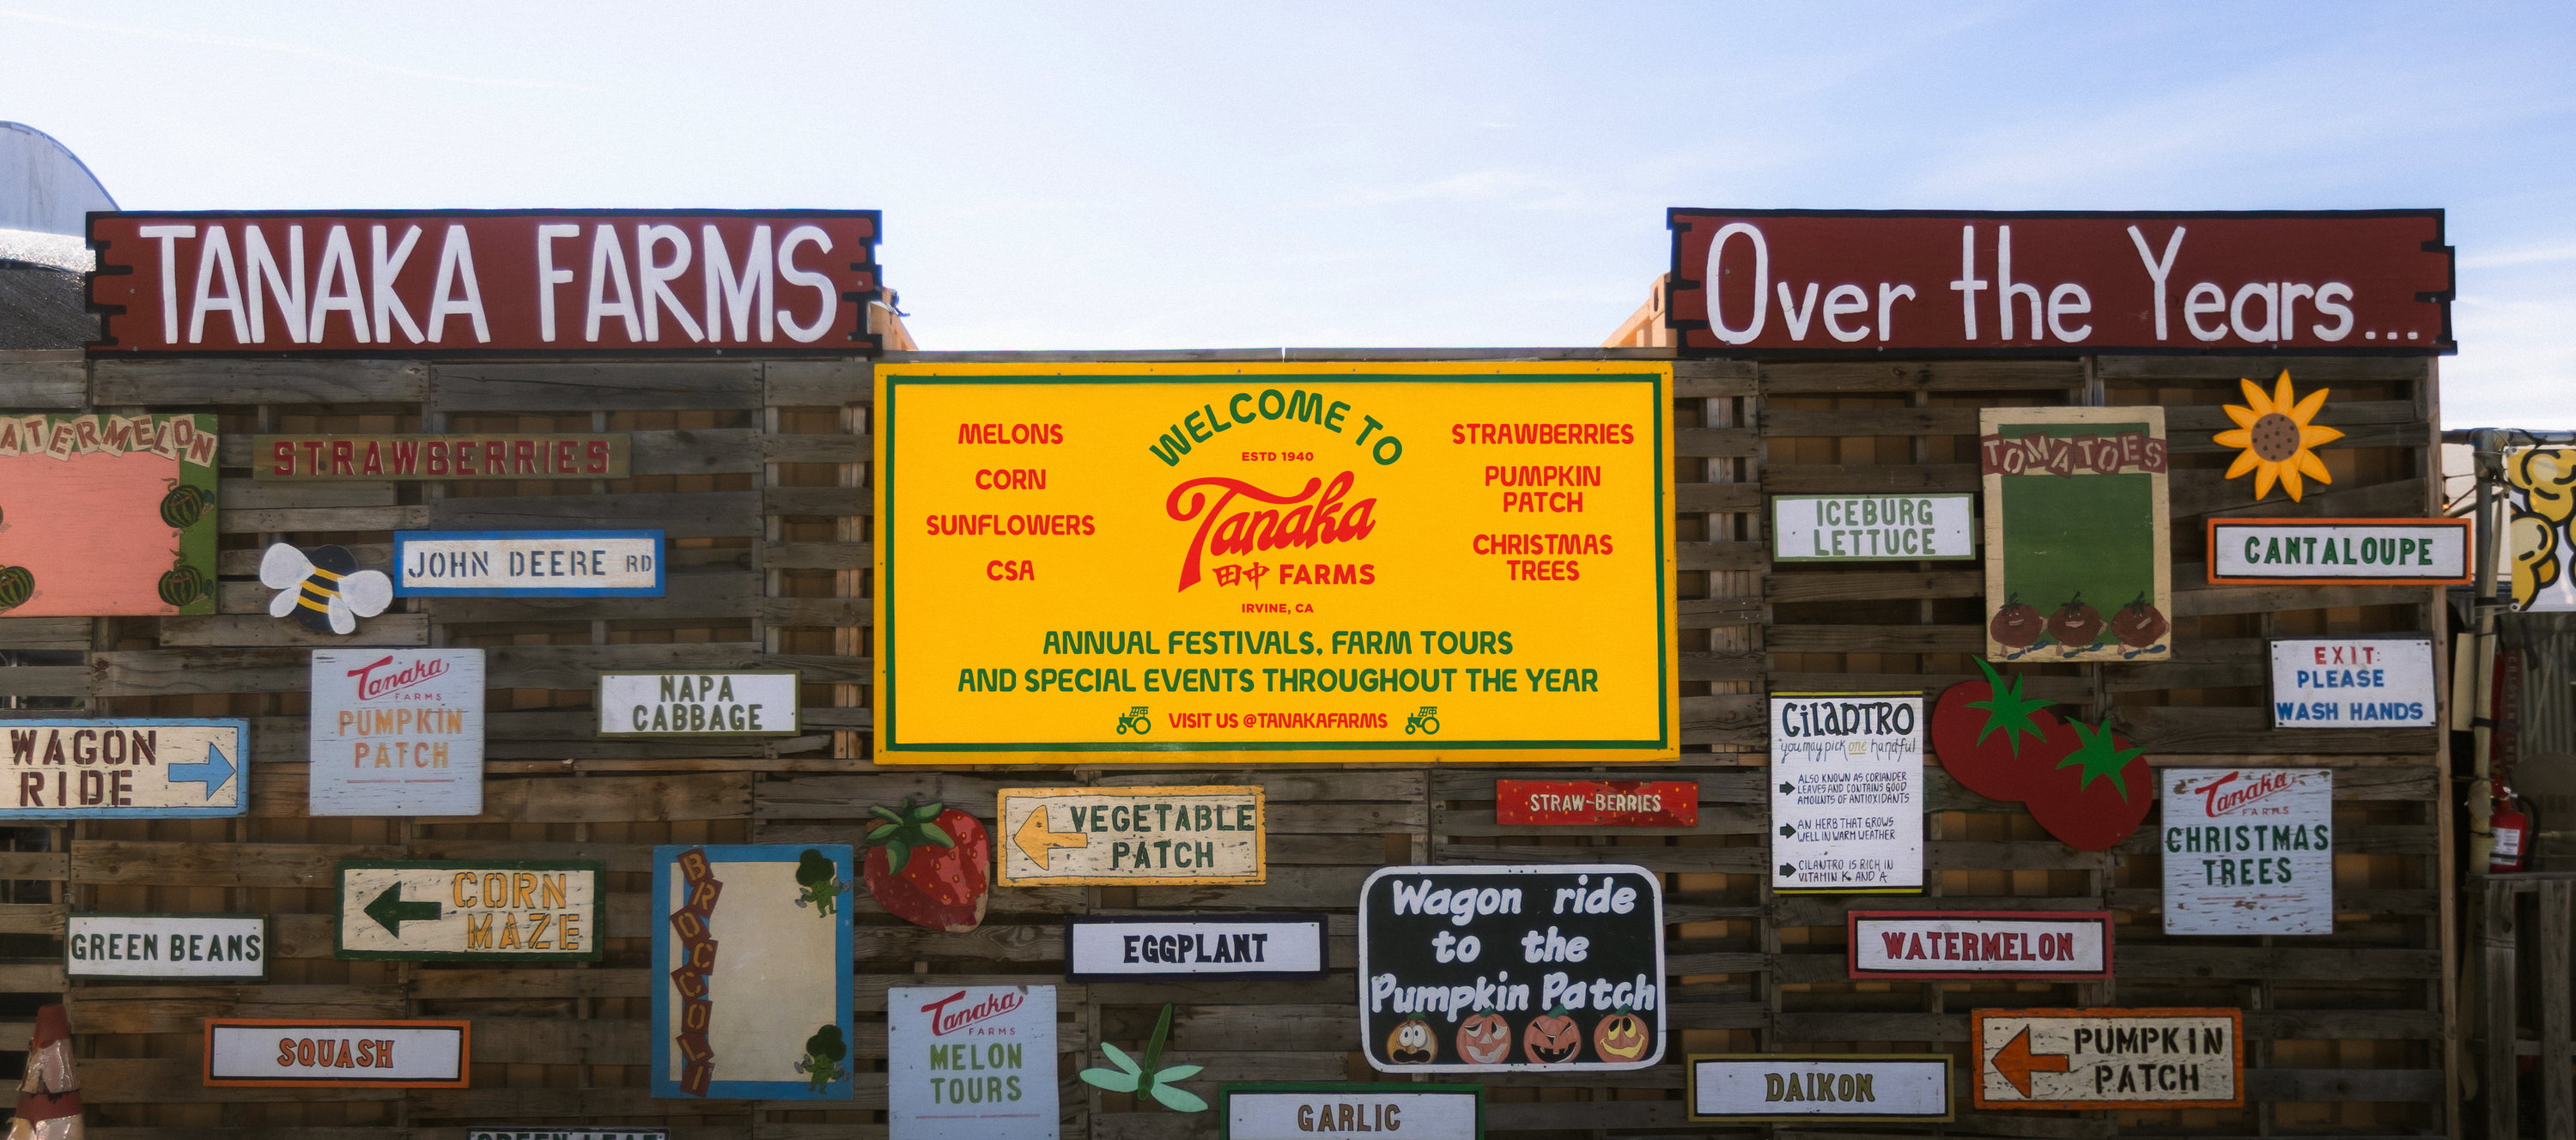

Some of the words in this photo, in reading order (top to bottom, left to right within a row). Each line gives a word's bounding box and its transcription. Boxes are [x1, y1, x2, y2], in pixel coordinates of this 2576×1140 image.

[140, 225, 491, 343] TANAKA
[538, 225, 837, 343] FARMS
[1706, 223, 1916, 344] Over
[1950, 226, 2092, 343] the
[2127, 226, 2418, 343] Years...
[0, 418, 214, 464] ATERMELON
[958, 424, 1063, 444] MELONS
[1149, 389, 1351, 466] WELCOME
[1356, 415, 1402, 465] TO
[1452, 423, 1634, 444] STRAWBERRIES
[273, 440, 610, 476] STRAWBERRIES
[1242, 452, 1276, 461] ESTD
[1282, 452, 1314, 461] 1940
[1984, 435, 2162, 473] TOMATOES
[975, 470, 1046, 489] CORN
[1485, 466, 1601, 487] PUMPKIN
[1504, 492, 1583, 512] PATCH
[1816, 499, 1934, 526] ICEBURG
[927, 515, 1095, 536] SUNFLOWERS
[1166, 470, 1377, 593] Tanaka
[1473, 534, 1613, 555] CHRISTMAS
[1814, 528, 1935, 556] LETTUCE
[2245, 537, 2433, 566] CANTALOUPE
[408, 551, 489, 578] JOHN
[509, 550, 606, 577] DEERE
[626, 555, 652, 573] RD
[987, 561, 1035, 581] CSA
[1212, 562, 1269, 591] 田中
[1280, 564, 1375, 585] FARMS
[1507, 561, 1579, 581] TREES
[1242, 603, 1291, 615] IRVINE,
[1296, 603, 1314, 613] CA
[1043, 631, 1160, 654] ANNUAL
[1169, 631, 1322, 656] FESTIVALS,
[1333, 631, 1412, 654] FARM
[1420, 631, 1513, 654] TOURS
[2315, 646, 2380, 664] EXIT:
[347, 655, 449, 701] Tanaka
[660, 676, 734, 702] NAPA
[958, 669, 1016, 692] AND
[1024, 669, 1136, 692] SPECIAL
[1145, 669, 1254, 692] EVENTS
[1263, 669, 1457, 692] THROUGHOUT
[1466, 669, 1517, 692] THE
[1526, 669, 1598, 692] YEAR
[2297, 670, 2385, 688] PLEASE
[395, 693, 442, 701] FARMS
[339, 708, 463, 737] PUMPKIN
[632, 704, 763, 732] CABBAGE
[1169, 713, 1212, 728] VISIT
[1217, 713, 1238, 728] US
[1243, 713, 1388, 728] @TANAKAFARMS
[2276, 702, 2338, 721] WASH
[2350, 702, 2423, 721] HANDS
[10, 730, 157, 766] WAGON
[355, 742, 449, 768] PATCH
[1780, 743, 1801, 764] you
[1802, 741, 1822, 762] may
[1825, 739, 1849, 762] pick
[1849, 741, 1867, 753] one
[1870, 737, 1916, 762] handful
[20, 770, 133, 807] RIDE
[1797, 784, 1826, 794] LEAVES
[1827, 784, 1844, 793] AND
[1846, 783, 1883, 793] CONTAINS
[1886, 782, 1907, 791] GOOD
[1798, 773, 1819, 784] ALSO
[1822, 773, 1850, 783] KNOWN
[1853, 773, 1863, 782] AS
[1865, 772, 1907, 782] CORIANDER
[1530, 793, 1662, 813] STRAW-BERRIES
[1797, 794, 1836, 805] AMOUNTS
[1838, 794, 1847, 803] OF
[1849, 792, 1910, 804] ANTIOXIDANTS
[2195, 771, 2296, 817] Tanaka
[1071, 804, 1255, 833] VEGETABLE
[1797, 819, 1812, 829] AN
[1815, 818, 1838, 829] HERB
[1840, 817, 1862, 828] THAT
[1865, 816, 1894, 829] GROWS
[2243, 807, 2288, 816] FARMS
[1797, 831, 1820, 842] WELL
[1821, 831, 1832, 841] IN
[1832, 830, 1856, 840] WARM
[1858, 829, 1896, 840] WEATHER
[2166, 824, 2329, 853] CHRISTMAS
[1113, 841, 1213, 869] PATCH
[1798, 859, 1844, 870] CILANTRO
[1849, 859, 1857, 870] IS
[1860, 858, 1880, 871] RICH
[1884, 859, 1893, 870] IN
[1798, 872, 1838, 882] VITAMIN
[1855, 871, 1875, 882] AND
[1879, 871, 1888, 882] A
[2202, 858, 2292, 886] TREES
[453, 872, 567, 909] CORN
[1393, 879, 1522, 925] Wagon
[1553, 875, 1637, 914] ride
[468, 913, 580, 950] MAZE
[1432, 931, 1480, 963] to
[1522, 926, 1589, 963] the
[71, 933, 159, 961] GREEN
[171, 934, 261, 961] BEANS
[1123, 933, 1267, 963] EGGPLANT
[1881, 931, 2075, 961] WATERMELON
[678, 852, 716, 1092] BROCCOLI
[1371, 971, 1529, 1022] Pumpkin
[1542, 972, 1656, 1011] Patch
[920, 991, 1024, 1036] Tanaka
[969, 1028, 1015, 1036] FARMS
[2074, 1028, 2223, 1054] PUMPKIN
[277, 1039, 395, 1069] SQUASH
[930, 1043, 1022, 1070] MELON
[930, 1076, 1022, 1104] TOURS
[1765, 1073, 1874, 1102] DAIKON
[2094, 1064, 2200, 1094] PATCH
[1297, 1103, 1401, 1132] GARLIC
